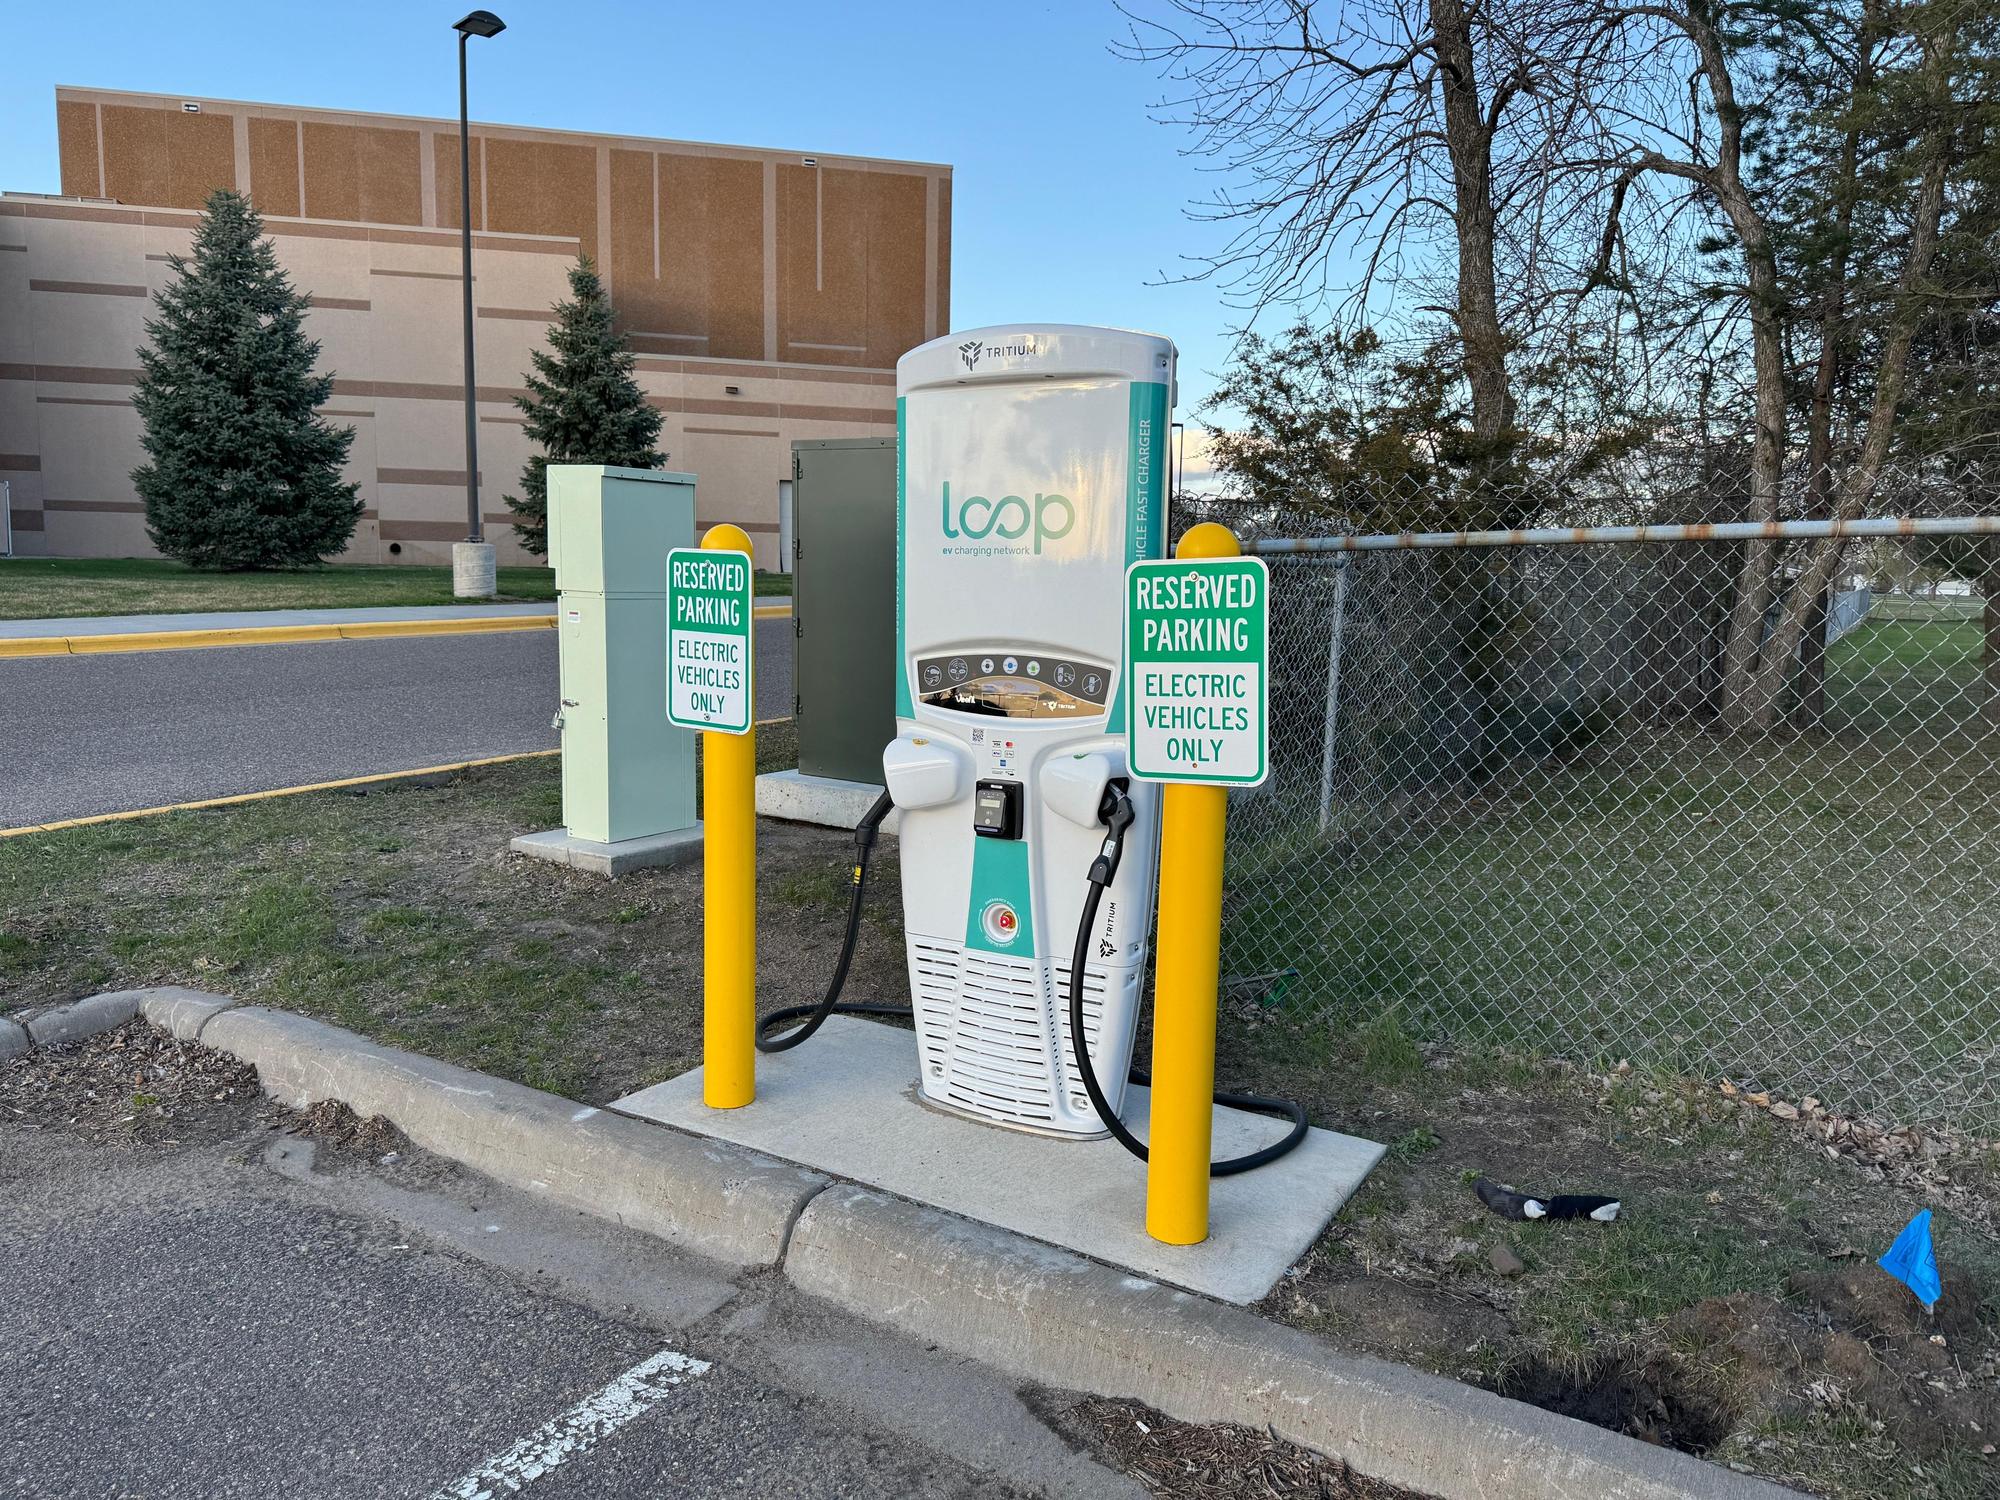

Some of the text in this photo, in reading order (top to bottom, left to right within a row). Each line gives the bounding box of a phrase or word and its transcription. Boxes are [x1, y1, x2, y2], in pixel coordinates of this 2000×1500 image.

[986, 345, 1036, 358] TRITIUM
[1135, 419, 1151, 560] HICLE FAST CHARGER
[942, 480, 1076, 555] loop
[942, 545, 1030, 557] ev charging network
[673, 561, 744, 592] RESERVED
[1136, 573, 1256, 610] RESERVED
[677, 595, 740, 626] PARKING
[1143, 617, 1249, 652] PARKING
[678, 639, 738, 664] ELECTRIC
[677, 665, 740, 690] VEHICLES
[1145, 673, 1246, 698] ELECTRIC
[690, 692, 725, 714] ONLY
[1143, 705, 1249, 731] VEHICLES
[1166, 738, 1224, 762] ONLY
[1105, 901, 1117, 938] TRITIUM
